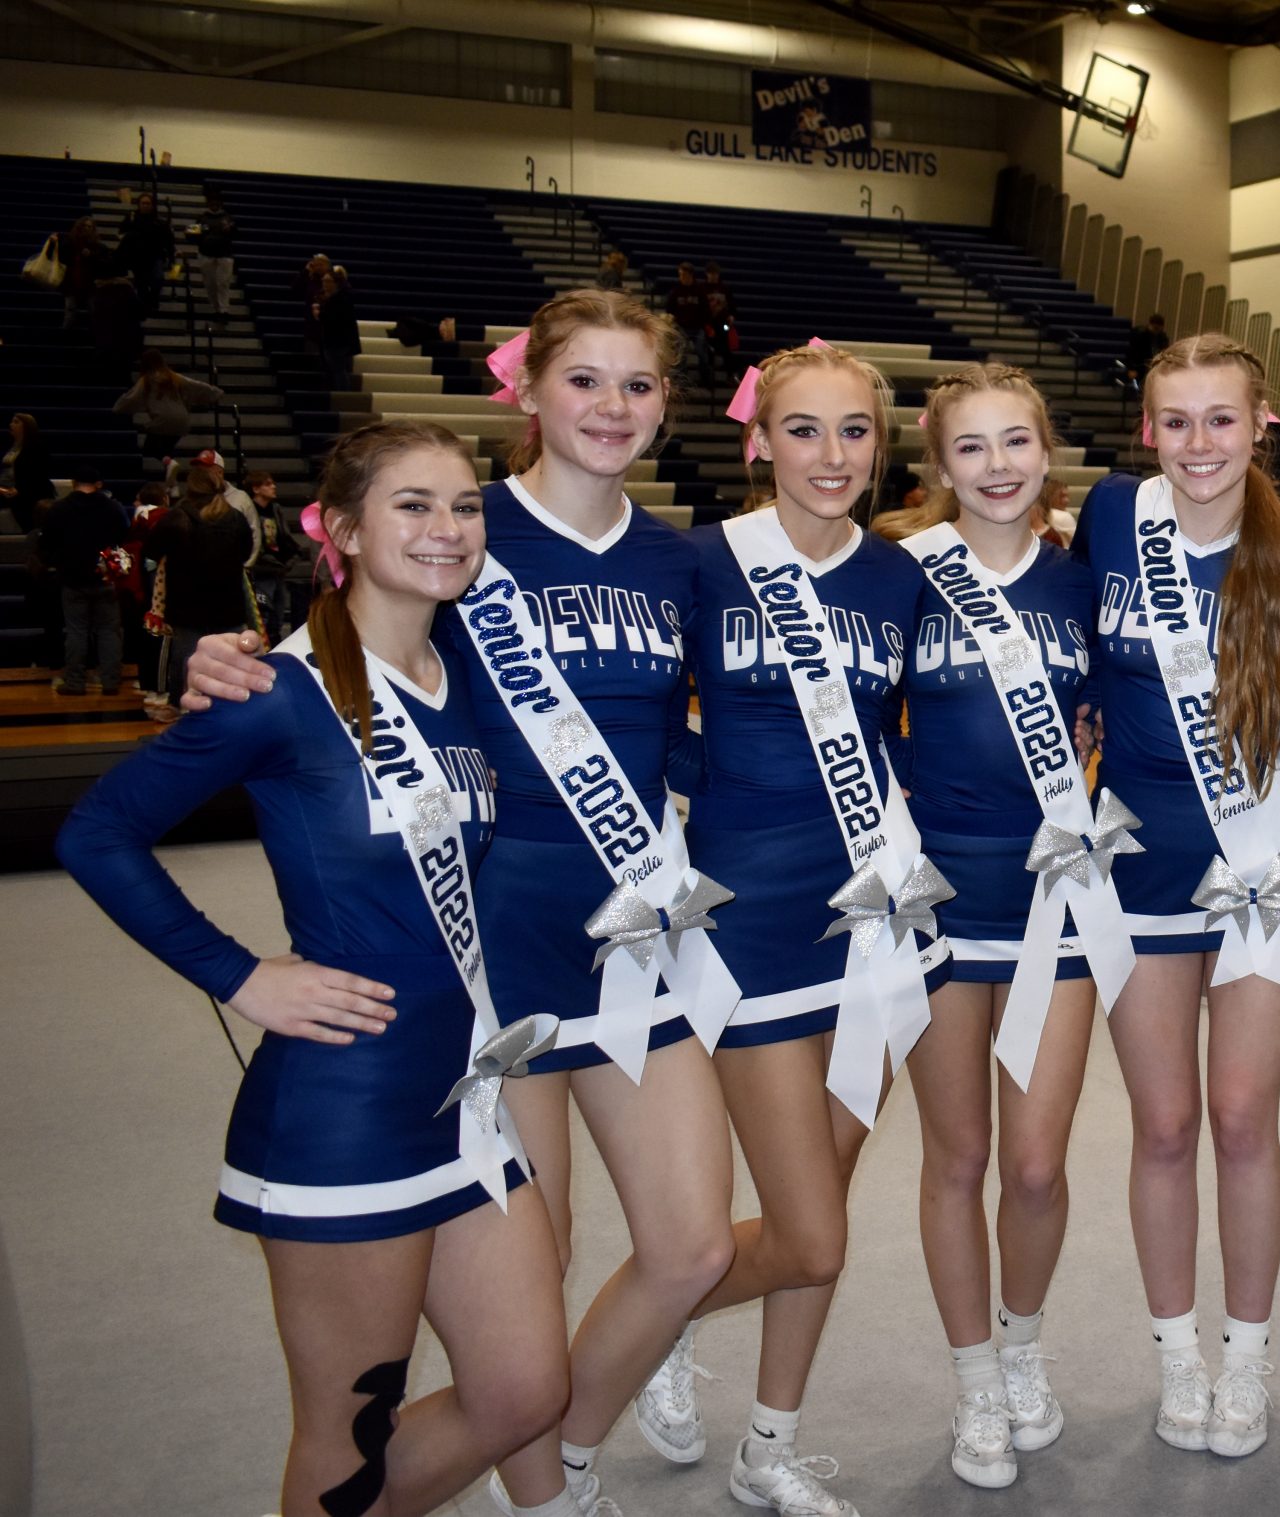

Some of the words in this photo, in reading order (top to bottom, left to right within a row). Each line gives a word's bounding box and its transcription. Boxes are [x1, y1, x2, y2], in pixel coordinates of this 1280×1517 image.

[756, 77, 830, 111] Devil's
[823, 123, 866, 147] Den
[685, 129, 746, 159] GULL
[755, 144, 814, 166] LAKE
[824, 147, 939, 177] STUDENTS
[1138, 518, 1190, 634] Senior
[1098, 571, 1222, 655] DEI
[723, 603, 904, 686] DILS
[915, 610, 1090, 677] DEILS
[1109, 642, 1148, 655] GUL
[561, 656, 605, 670] ULL
[921, 543, 1012, 635] Senior
[1005, 680, 1069, 780] 2022
[940, 669, 984, 683] GUL
[1047, 670, 1080, 686] AKE
[751, 670, 777, 684] GU
[855, 676, 889, 696] AKE
[749, 562, 832, 683] Senior
[818, 731, 882, 839] 2022
[460, 578, 561, 714] Senior
[558, 753, 652, 869] 2022
[1043, 776, 1074, 803] Holly
[305, 652, 425, 789] ior
[419, 836, 476, 963] 2022
[1213, 796, 1257, 826] Jenna
[850, 832, 888, 862] Taylor
[621, 854, 664, 888] Bella
